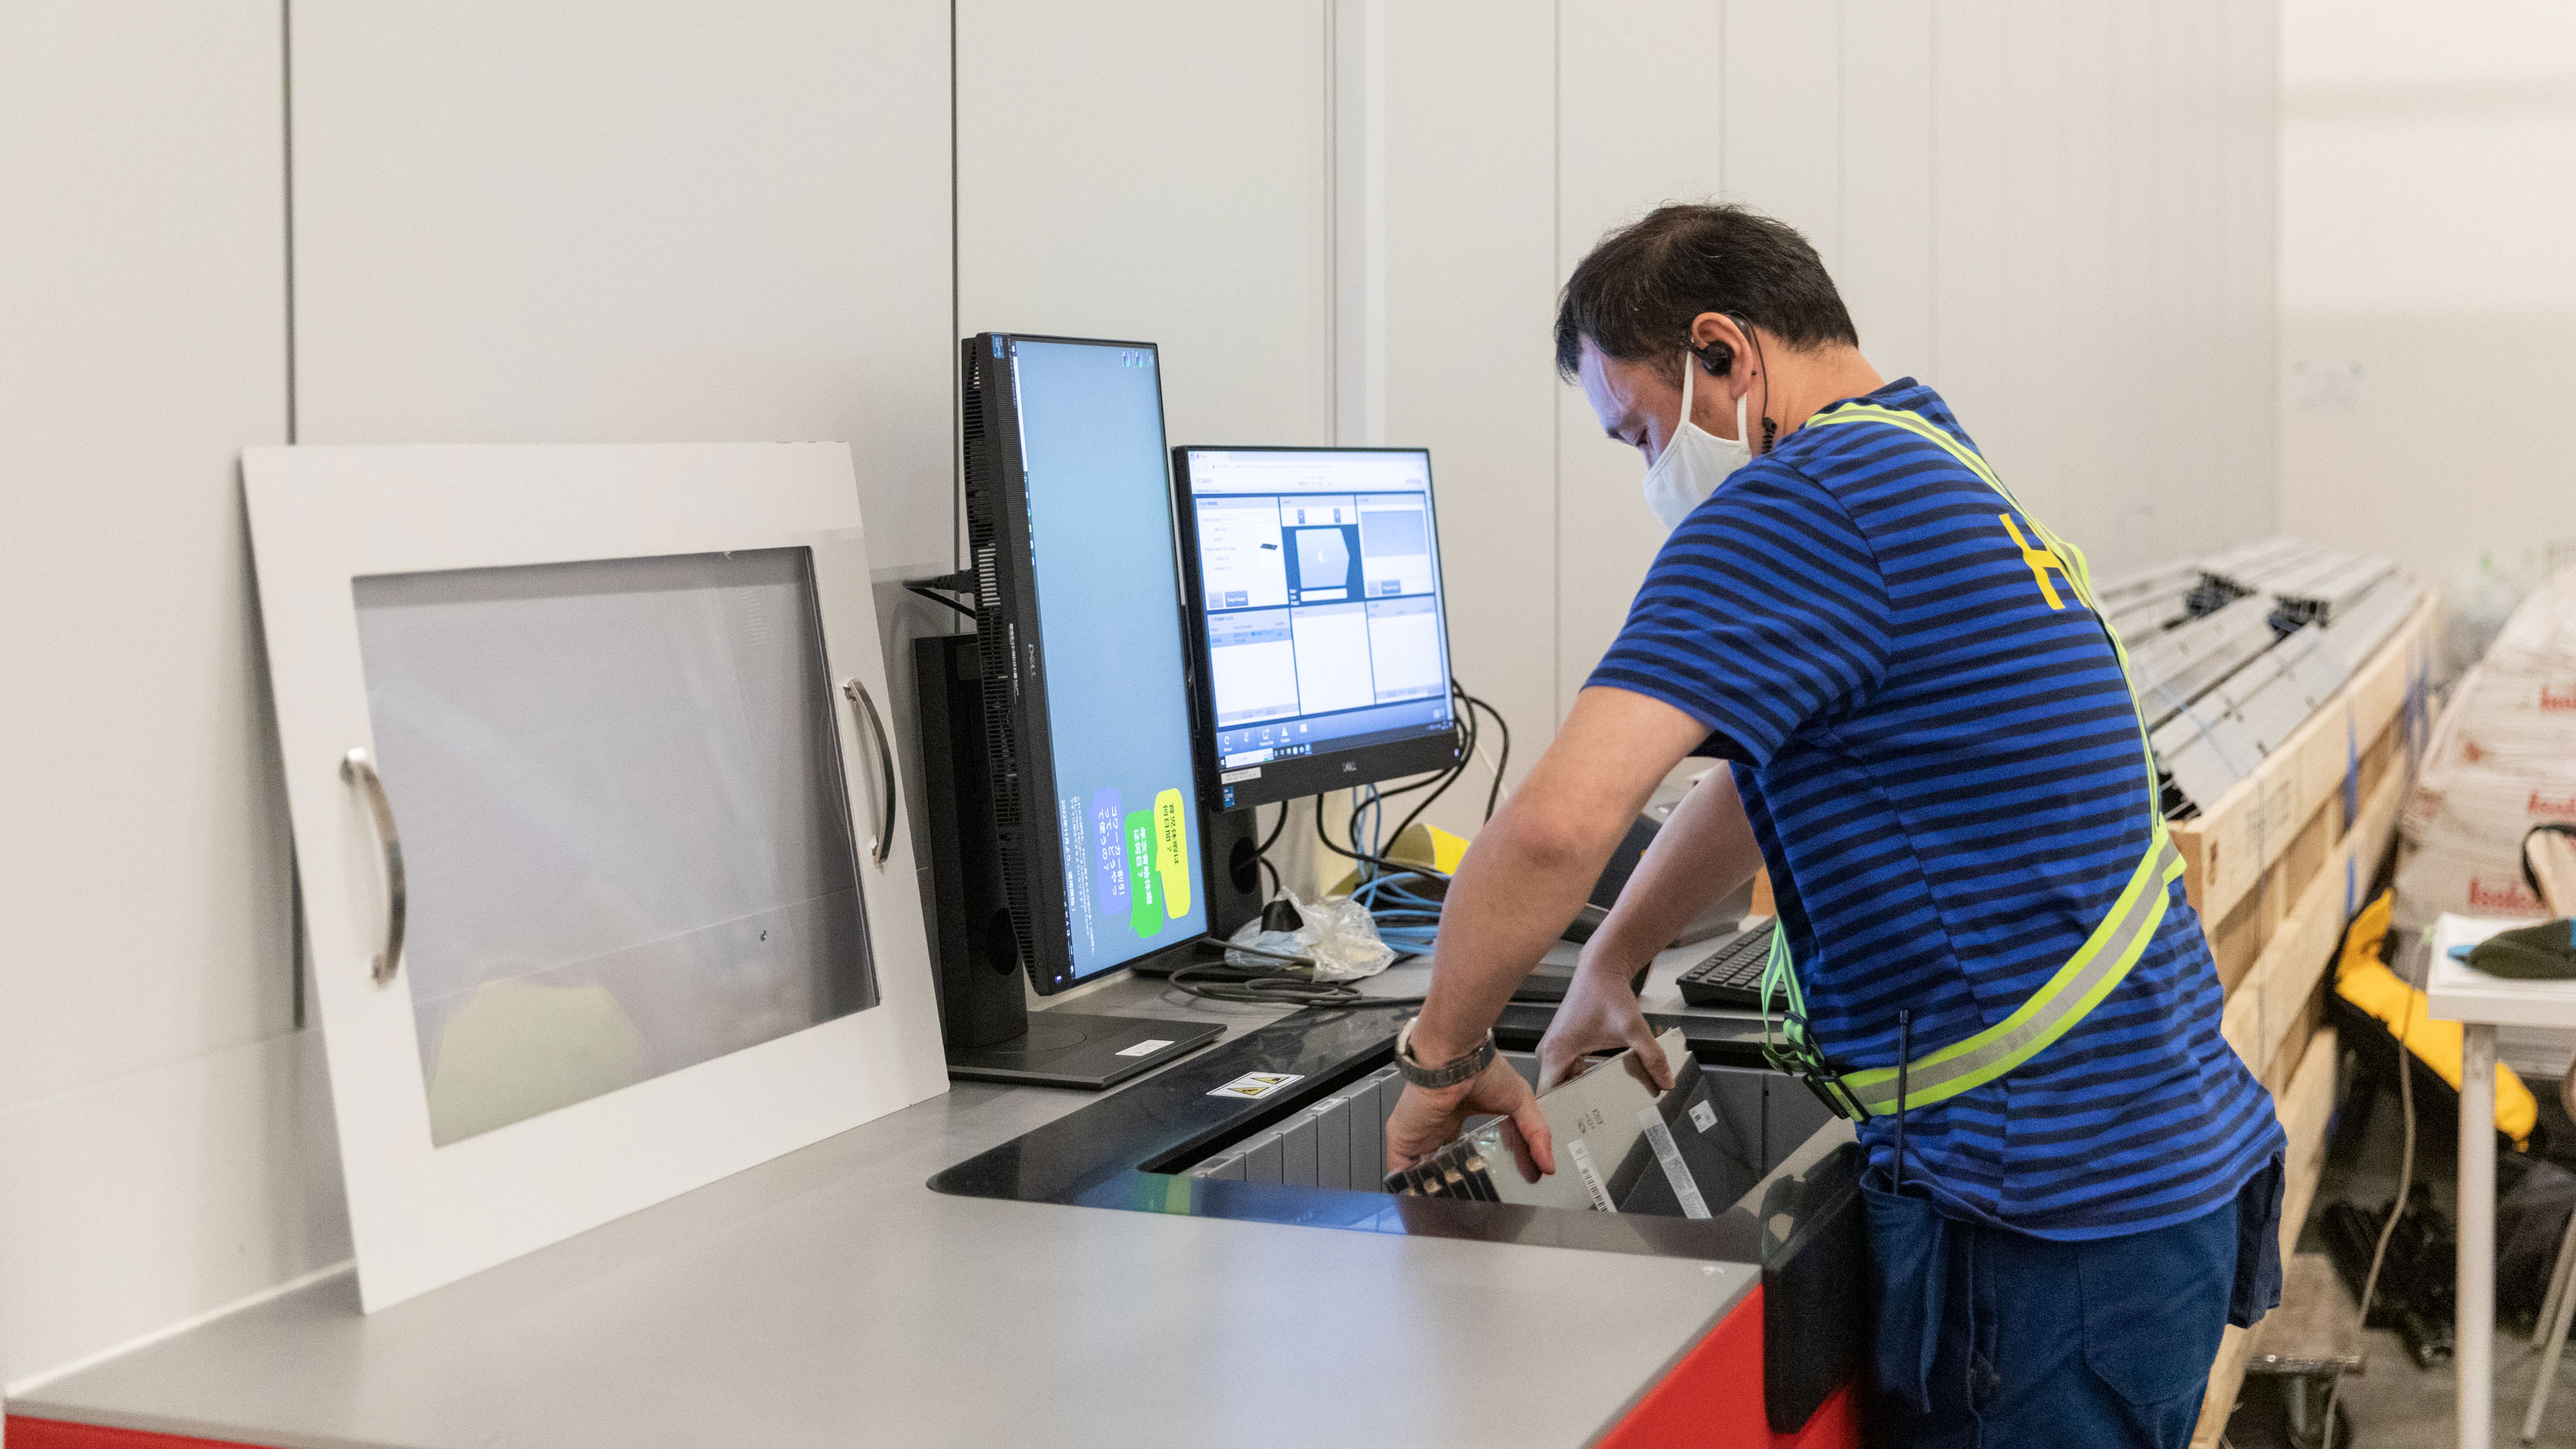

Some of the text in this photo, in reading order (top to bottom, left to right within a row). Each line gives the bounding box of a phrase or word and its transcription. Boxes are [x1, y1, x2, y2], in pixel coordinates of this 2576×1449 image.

[1111, 806, 1125, 896] コワーカー割引
